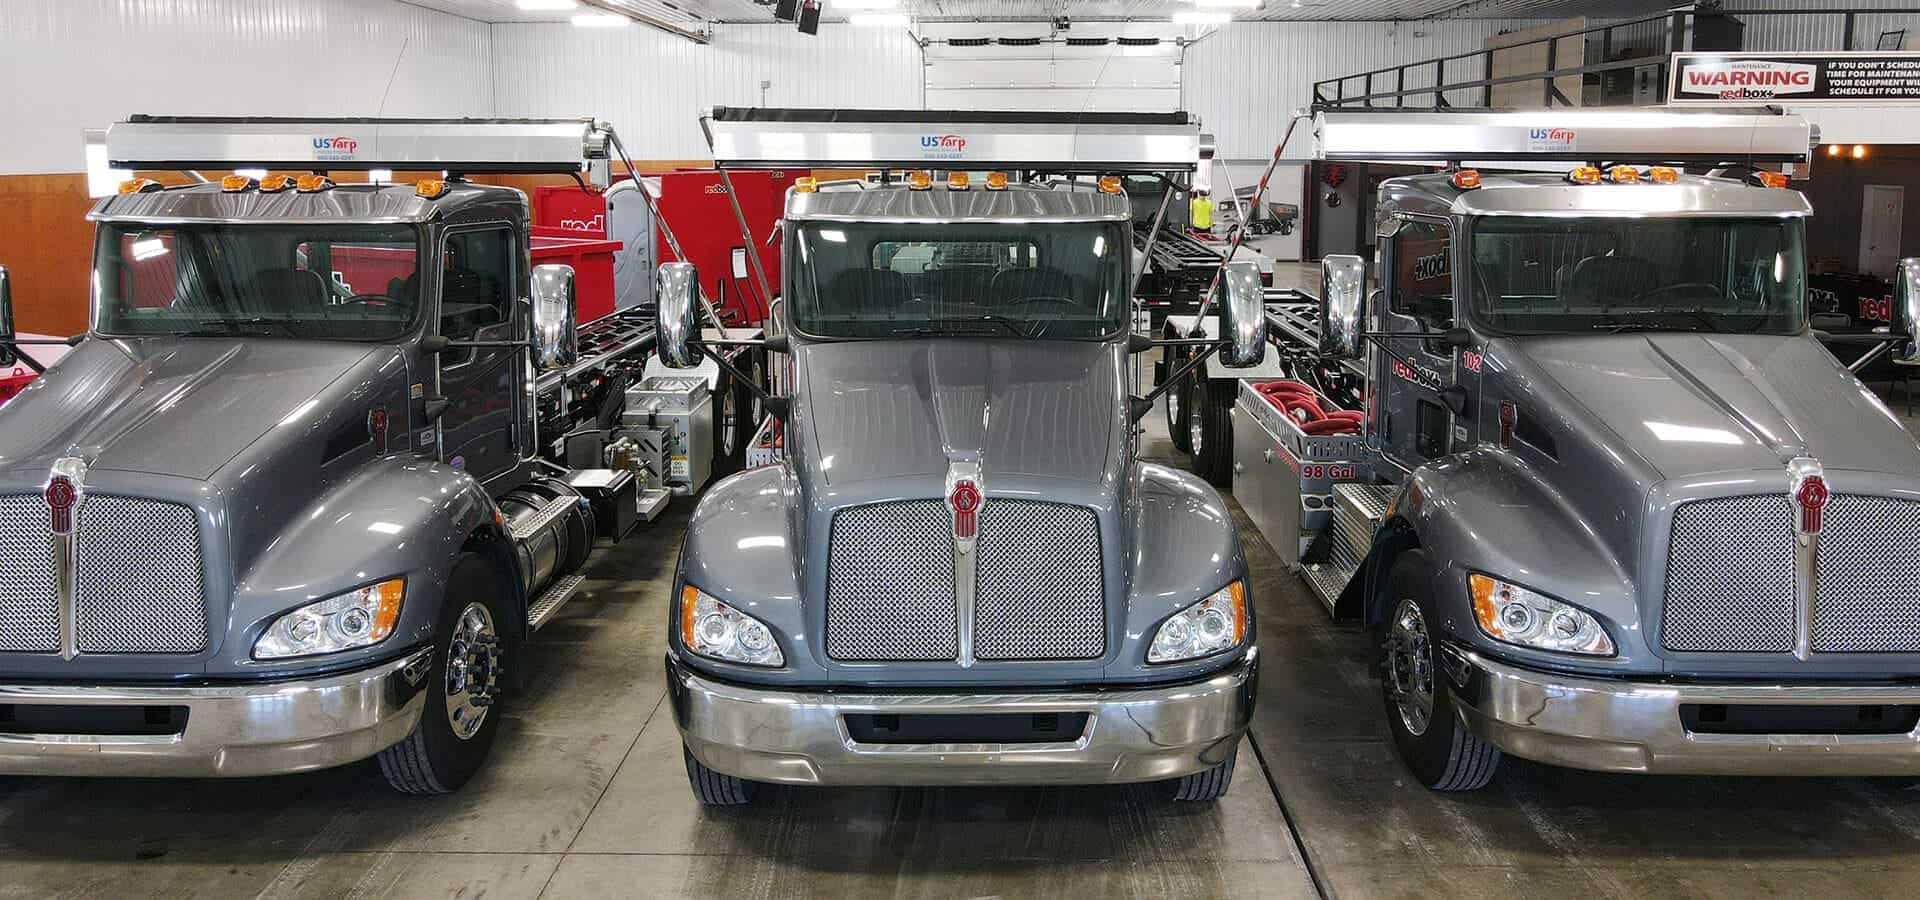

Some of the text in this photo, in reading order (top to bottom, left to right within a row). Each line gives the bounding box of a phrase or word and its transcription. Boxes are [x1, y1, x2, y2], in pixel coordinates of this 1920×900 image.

[1688, 71, 1809, 85] WARNING
[1826, 70, 1847, 78] TIME
[1848, 70, 1866, 78] FOR
[1829, 79, 1853, 87] YOUR
[1854, 79, 1905, 87] EQUIPMENT
[1720, 88, 1775, 99] redbox+
[1463, 350, 1482, 373] 102
[1303, 465, 1356, 479] 98 Gal
